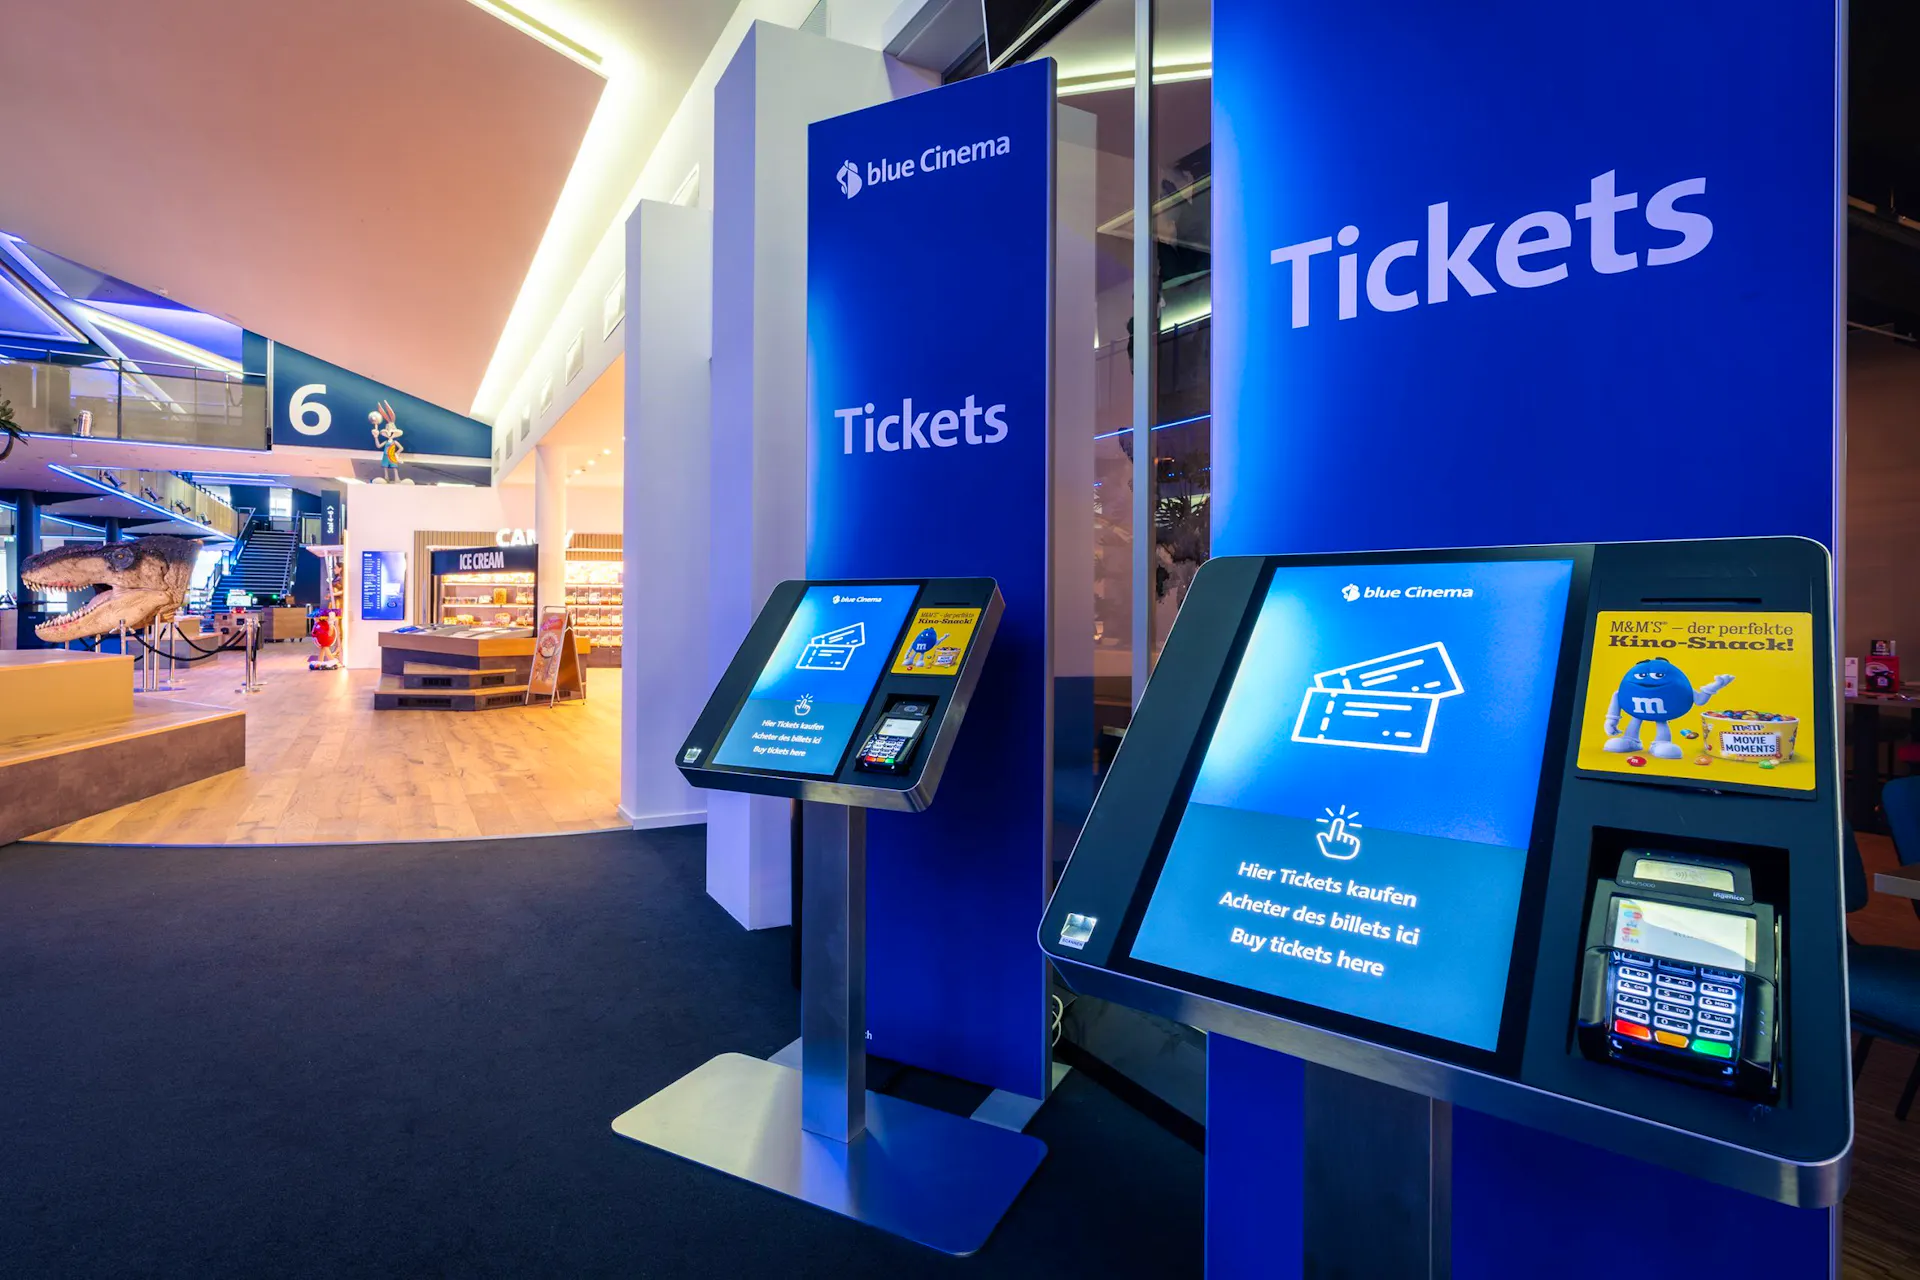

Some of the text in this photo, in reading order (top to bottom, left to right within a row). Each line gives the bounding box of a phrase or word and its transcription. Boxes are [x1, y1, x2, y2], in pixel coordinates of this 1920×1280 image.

[868, 136, 1010, 186] blue Cinema
[1270, 169, 1714, 329] Tickets
[289, 384, 331, 435] 6
[834, 394, 1008, 454] Tickets
[460, 552, 504, 570] ICE CREAM
[1364, 586, 1474, 598] blue Cinema
[1687, 622, 1714, 634] der
[1719, 622, 1793, 638] perfekte
[1608, 635, 1794, 651] Kino-Snack!
[1632, 697, 1667, 714] m
[777, 721, 799, 729] Tickets
[800, 722, 824, 730] kaufen
[752, 732, 778, 740] Acheter
[791, 735, 812, 744] billets
[812, 736, 822, 744] ici
[1733, 736, 1766, 744] MOVIE
[753, 746, 806, 756] Buy tickets here
[1726, 744, 1776, 752] MOMENTS
[1238, 862, 1417, 908] Hier Tickets kaufen
[1713, 892, 1744, 902] ingenico
[1219, 892, 1420, 946] Acheter des billets ici
[1230, 928, 1385, 976] Buy tickets here
